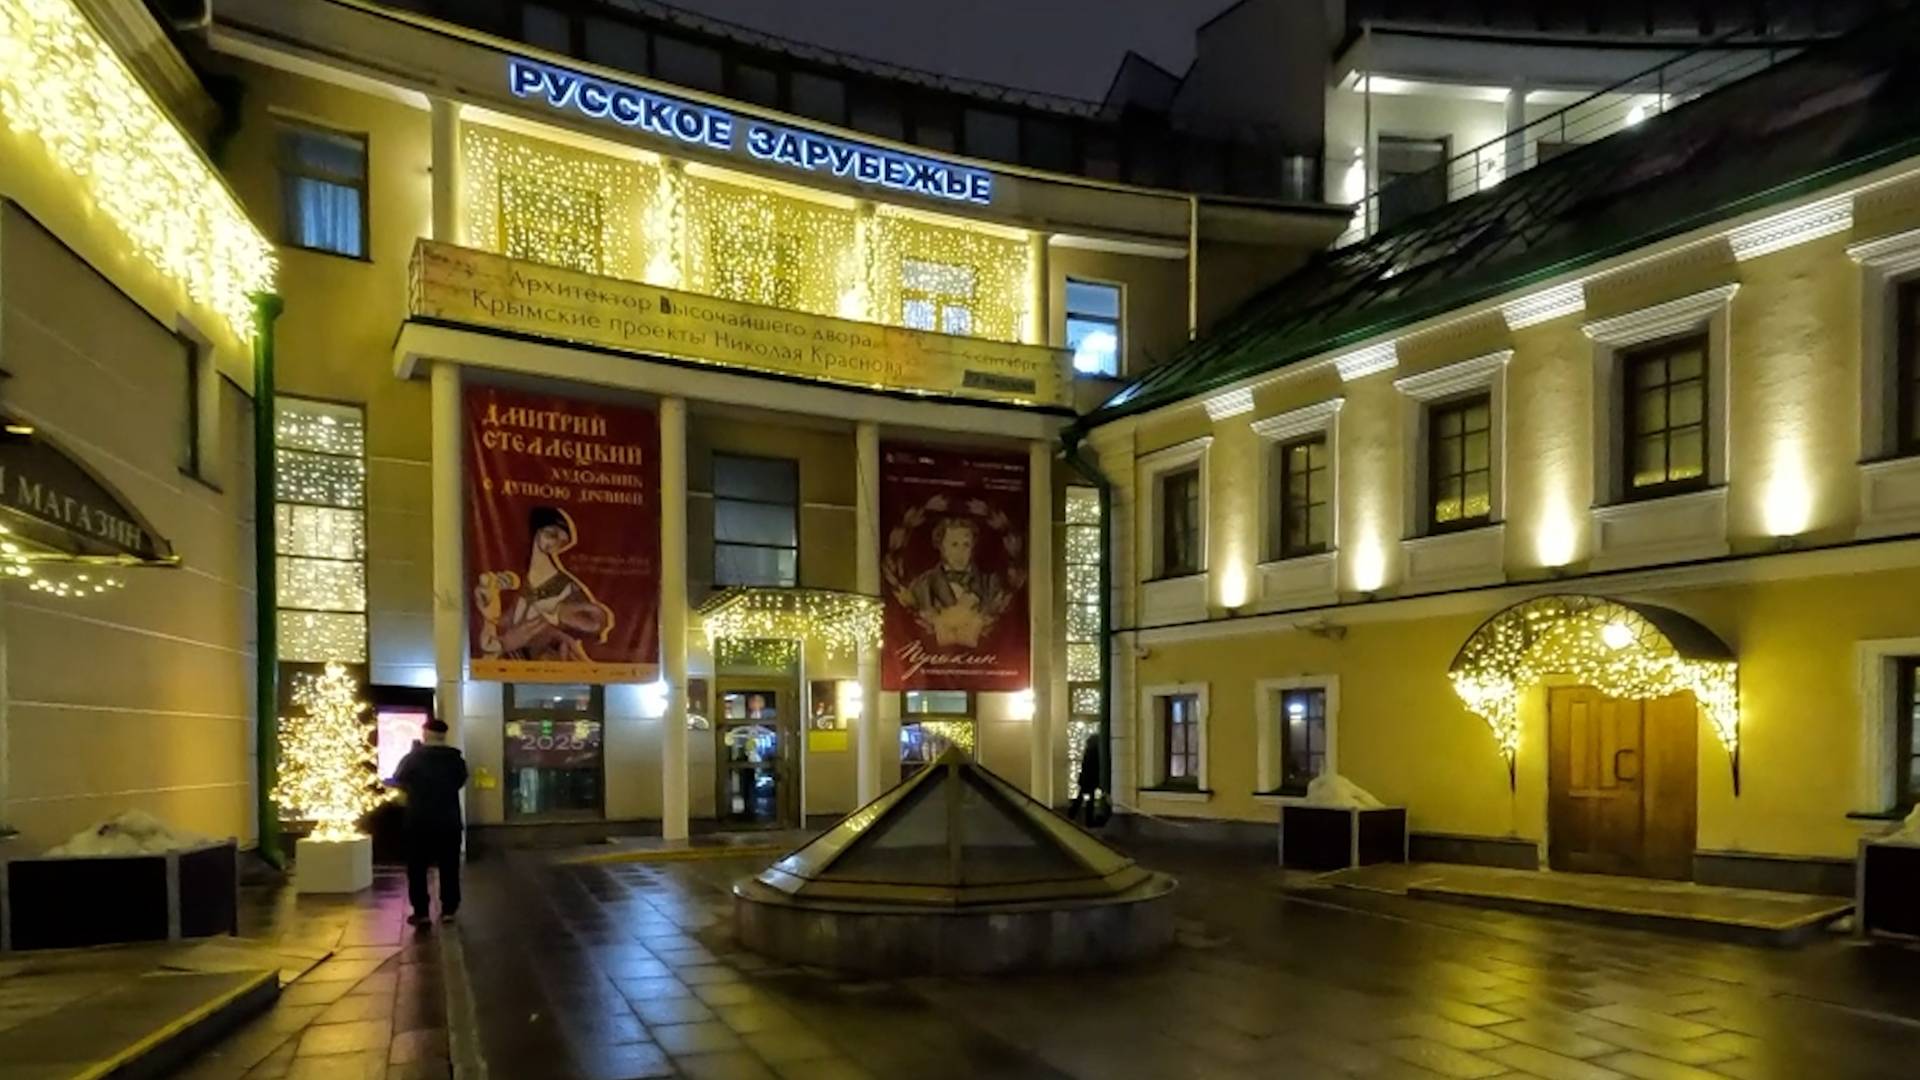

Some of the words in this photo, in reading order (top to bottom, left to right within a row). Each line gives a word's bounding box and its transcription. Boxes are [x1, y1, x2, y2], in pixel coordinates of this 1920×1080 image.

[508, 60, 734, 148] РУССКОЕ
[746, 123, 992, 203] ЗАРУБЕЖЬЕ
[472, 287, 602, 329] Крымские
[609, 314, 707, 346] проекты
[714, 329, 804, 362] Николая
[510, 270, 652, 312] Архитектор
[659, 295, 806, 337] Высочайшего
[18, 475, 142, 550] МАГАЗИН
[521, 734, 585, 750] 2025
